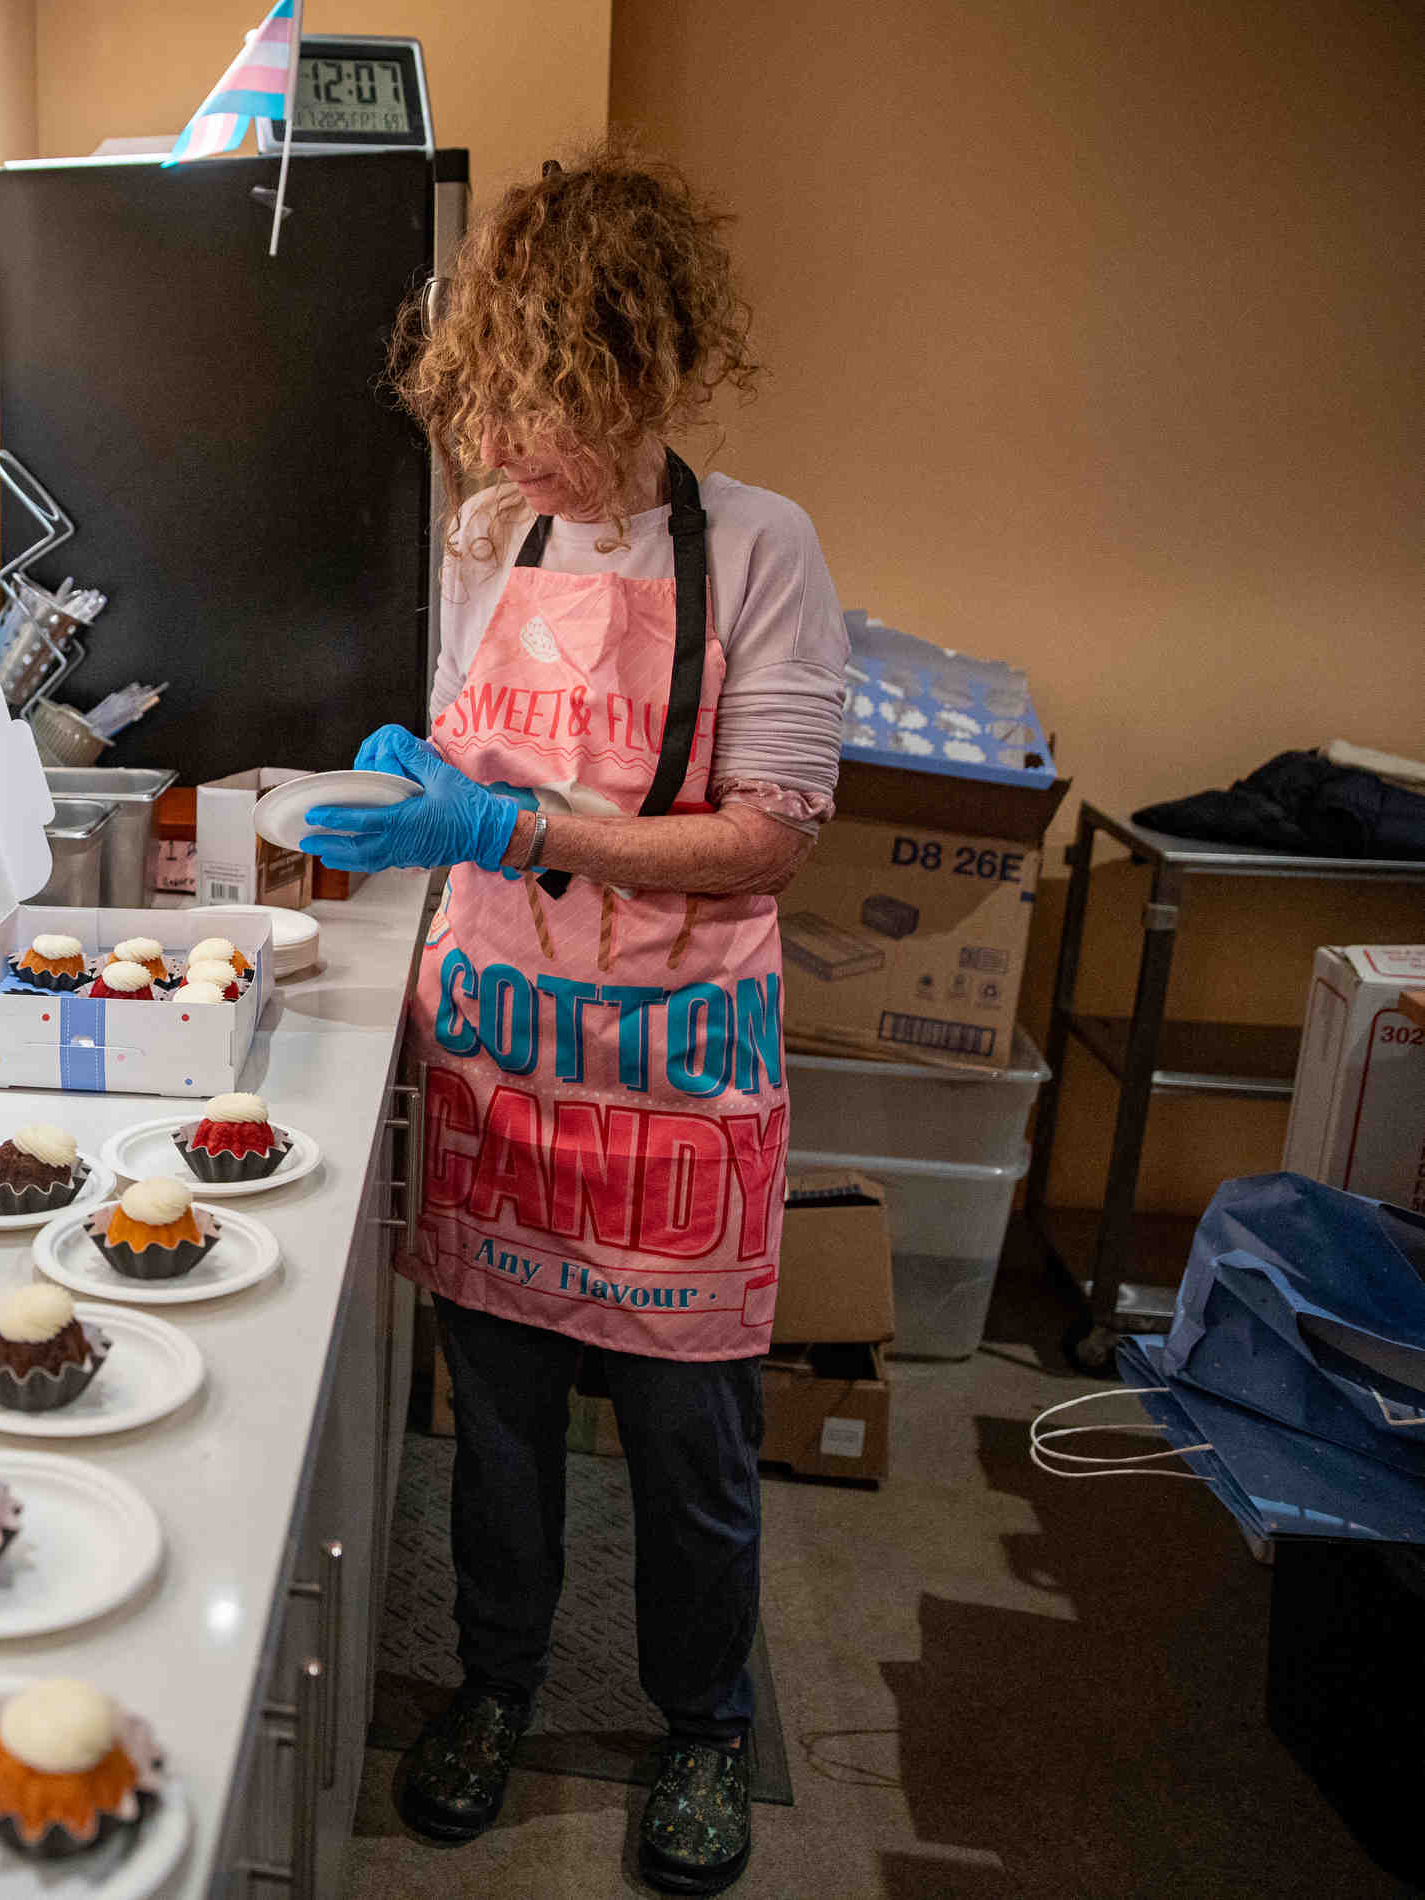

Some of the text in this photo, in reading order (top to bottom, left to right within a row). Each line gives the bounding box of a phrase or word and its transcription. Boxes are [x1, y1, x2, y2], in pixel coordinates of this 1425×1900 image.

[311, 61, 400, 104] 12:07
[451, 682, 567, 739] SWEET
[890, 835, 1025, 883] D8 26E
[435, 948, 782, 1099] COTTON
[424, 1066, 786, 1262] CANDY
[475, 1238, 698, 1309] Any Flavour
